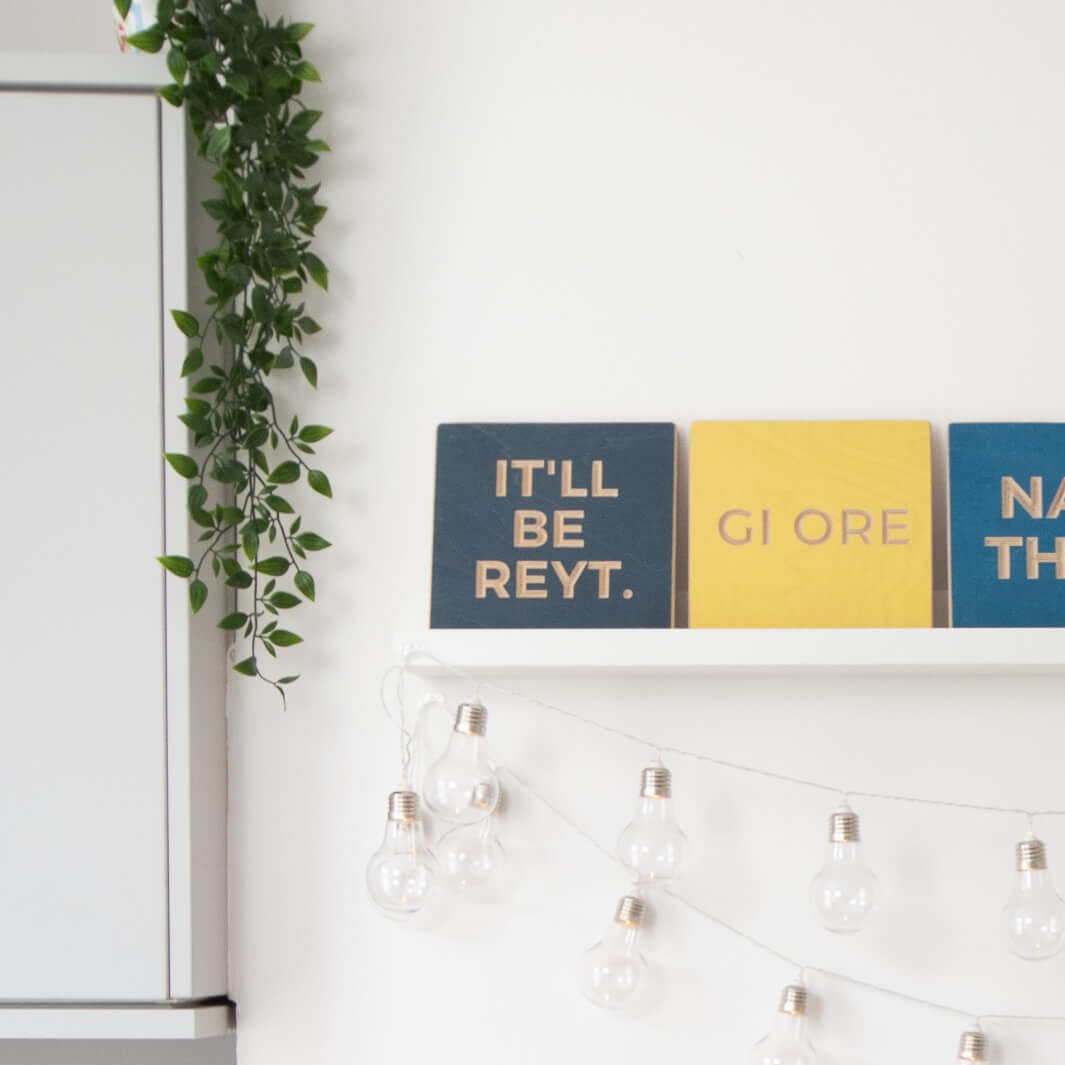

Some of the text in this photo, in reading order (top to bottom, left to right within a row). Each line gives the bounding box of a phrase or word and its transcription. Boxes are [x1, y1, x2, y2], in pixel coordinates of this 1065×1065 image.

[495, 460, 619, 498] IT'LL
[513, 510, 585, 549] BE
[718, 509, 911, 546] GI ORE
[475, 559, 634, 600] REYT.
